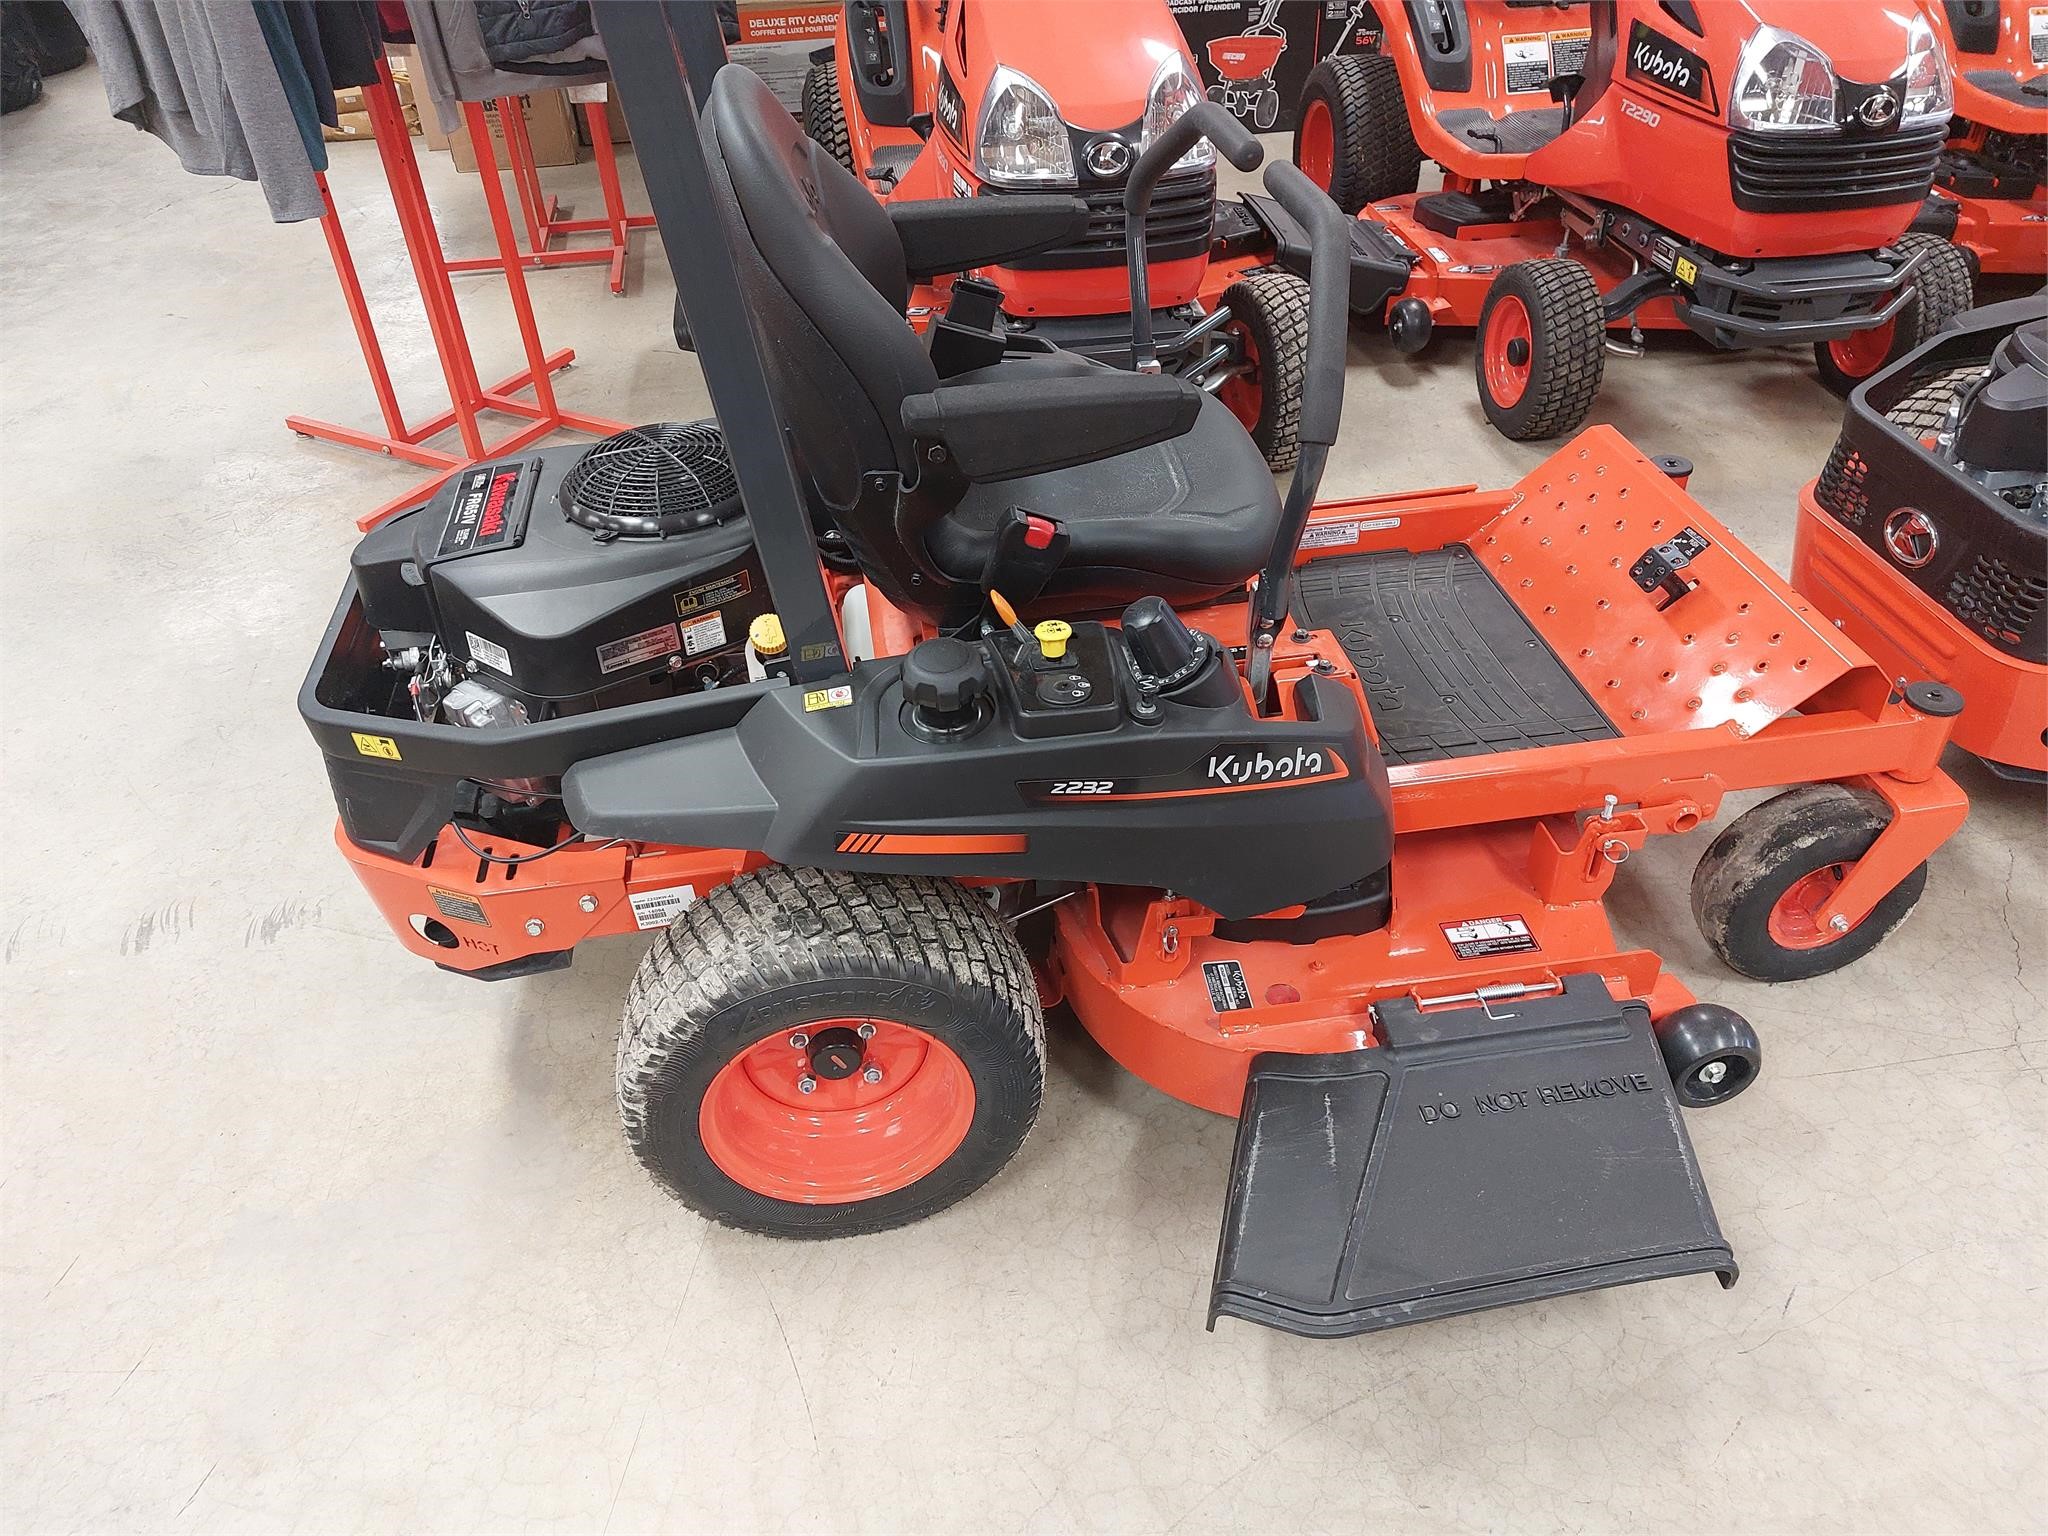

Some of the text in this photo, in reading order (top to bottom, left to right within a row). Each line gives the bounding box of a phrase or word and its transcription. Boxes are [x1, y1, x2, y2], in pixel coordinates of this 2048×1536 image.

[1204, 2, 1241, 12] ÉPANDEUR
[749, 17, 786, 28] DELUXE
[788, 16, 806, 26] RTV
[750, 28, 777, 37] COFFRE
[787, 26, 805, 34] LUXE
[805, 25, 824, 33] POUR
[1355, 36, 1376, 45] 56V
[1634, 41, 1690, 88] Kubota
[1620, 98, 1661, 128] T2290
[461, 492, 483, 525] FR651V
[479, 471, 517, 537] Kawasaki
[1315, 529, 1341, 537] WARNING
[1339, 622, 1406, 712] Kubota
[1208, 747, 1322, 784] Kubota
[1050, 781, 1114, 795] Z232
[1469, 917, 1503, 926] DANGER
[1232, 970, 1247, 999] Kubota
[1418, 1072, 1653, 1124] DO NOT REMOVE
